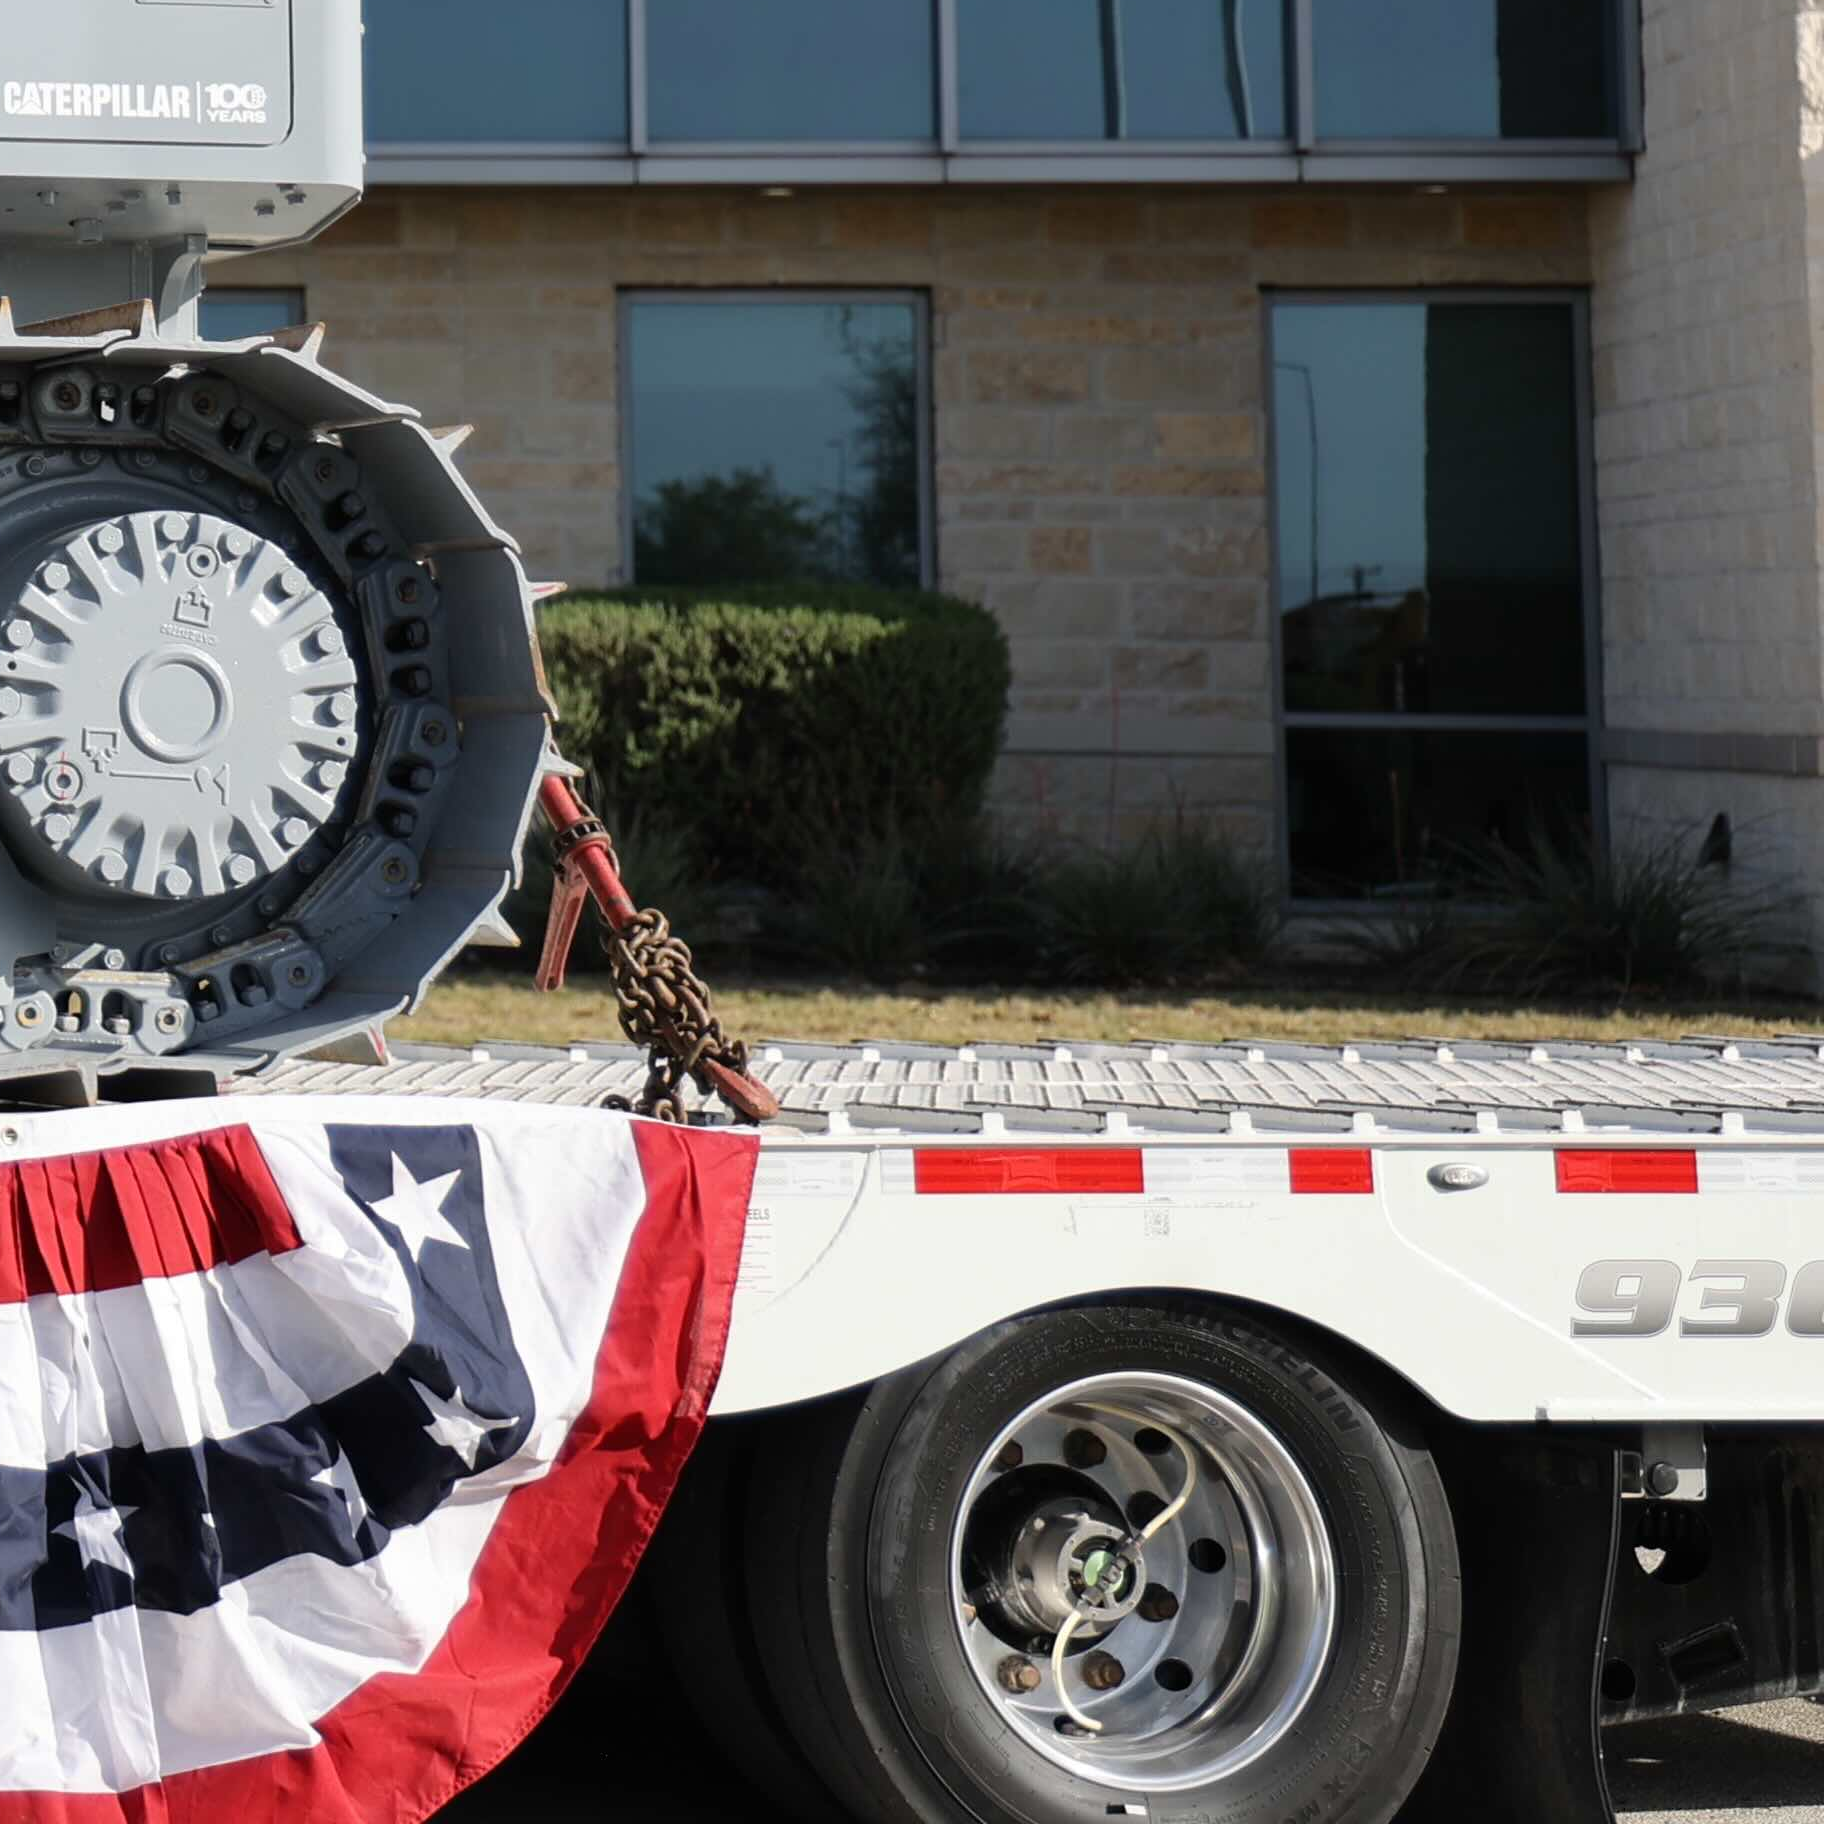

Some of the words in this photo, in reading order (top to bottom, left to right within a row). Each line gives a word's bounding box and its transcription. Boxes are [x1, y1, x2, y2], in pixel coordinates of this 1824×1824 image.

[3, 81, 190, 118] CATERPILLAR
[205, 83, 266, 109] 100
[206, 109, 266, 123] YEARS
